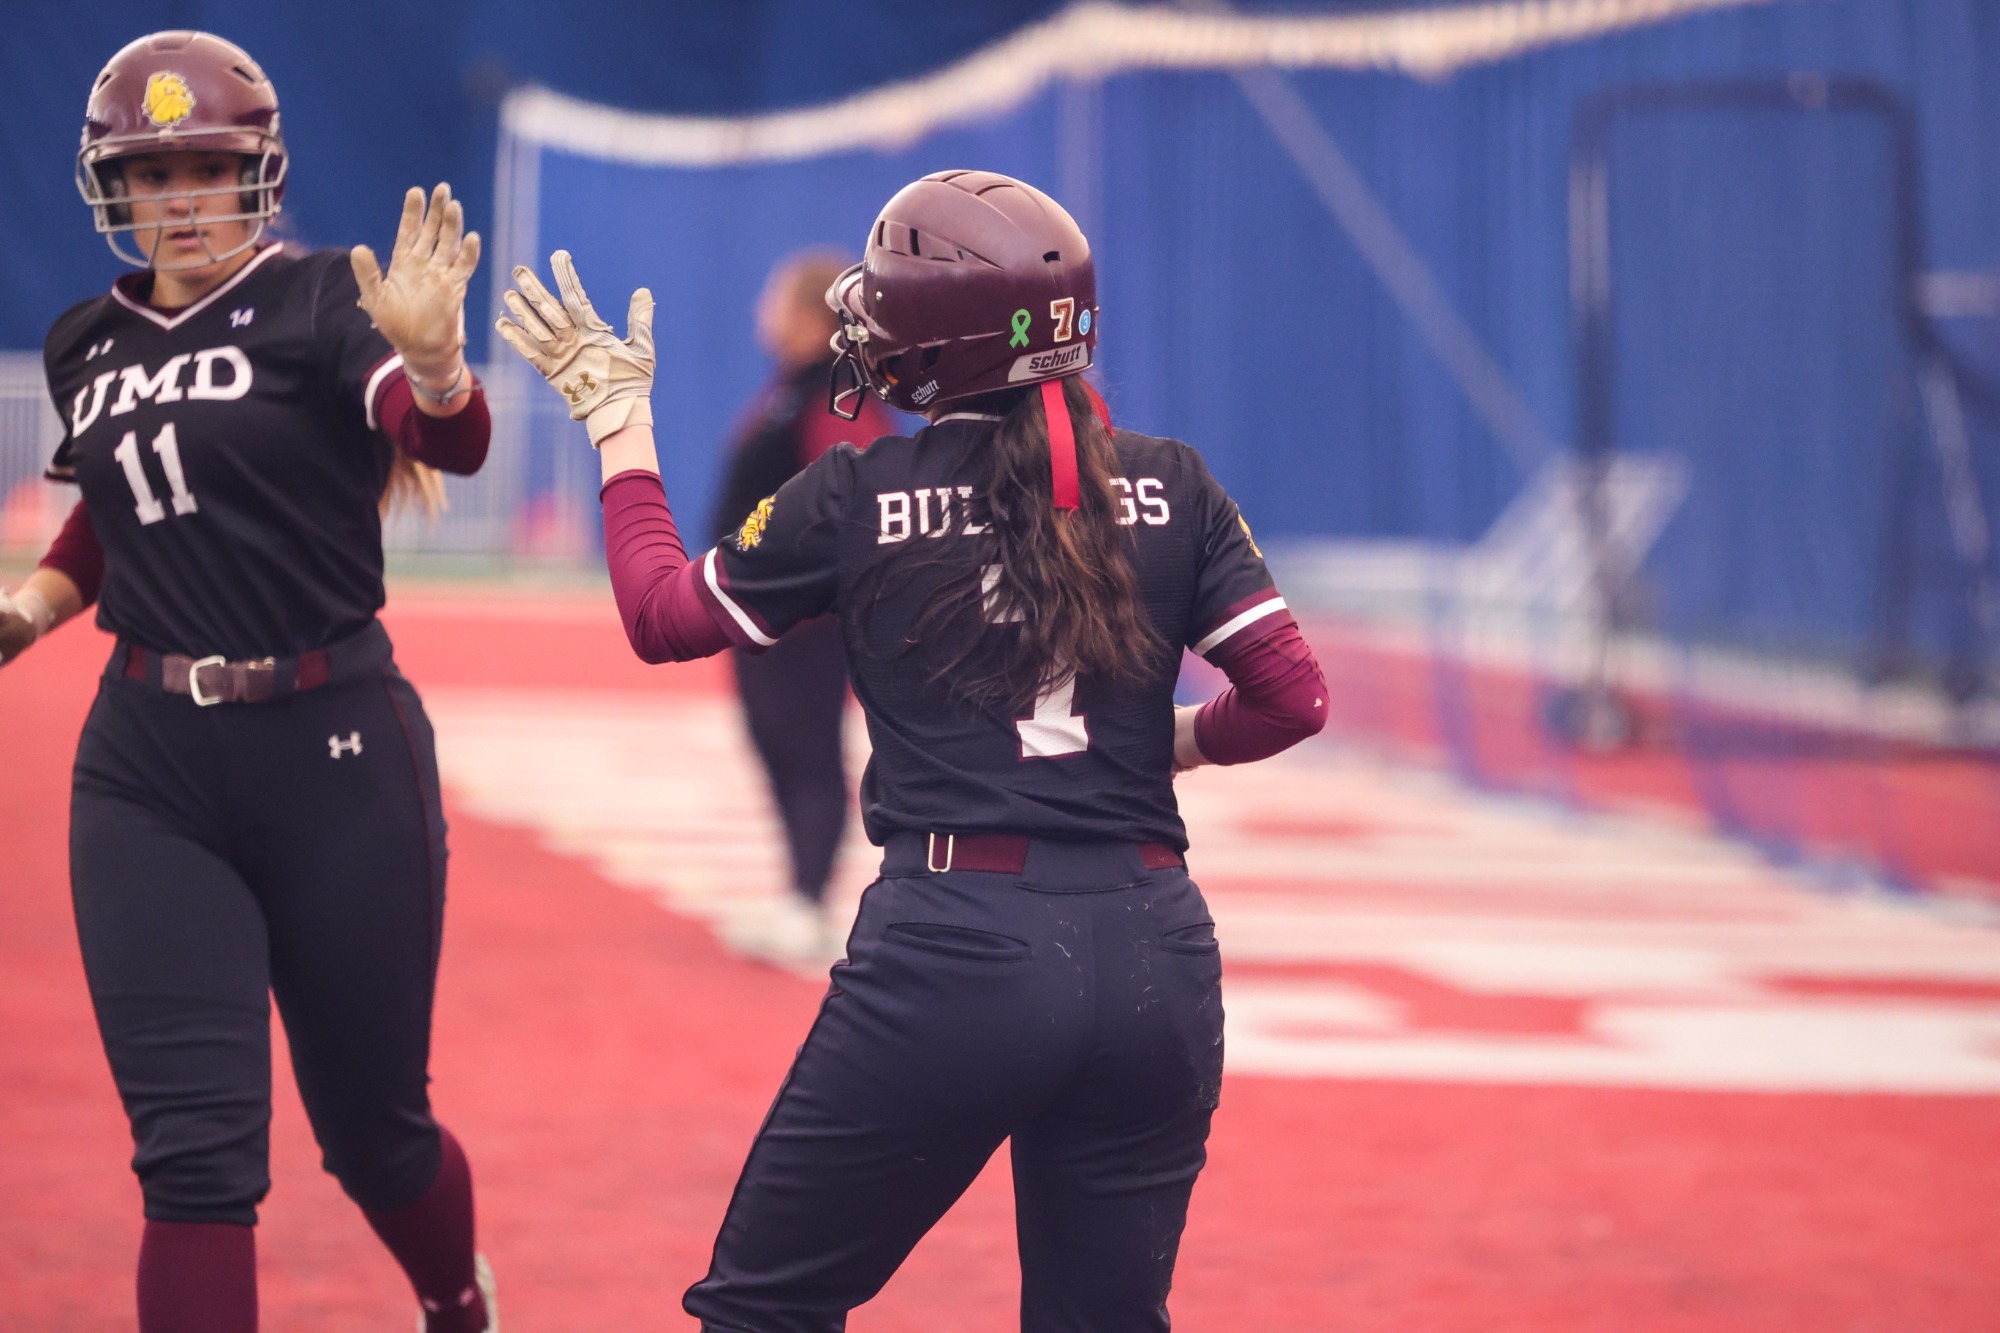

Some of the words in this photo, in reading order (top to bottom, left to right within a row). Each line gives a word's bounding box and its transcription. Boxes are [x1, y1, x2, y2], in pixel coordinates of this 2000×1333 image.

[1051, 297, 1074, 342] 7
[1029, 346, 1081, 370] schutt
[72, 345, 253, 438] UMD
[911, 379, 940, 403] schutt
[114, 422, 198, 526] 11
[876, 477, 1170, 544] BULGS
